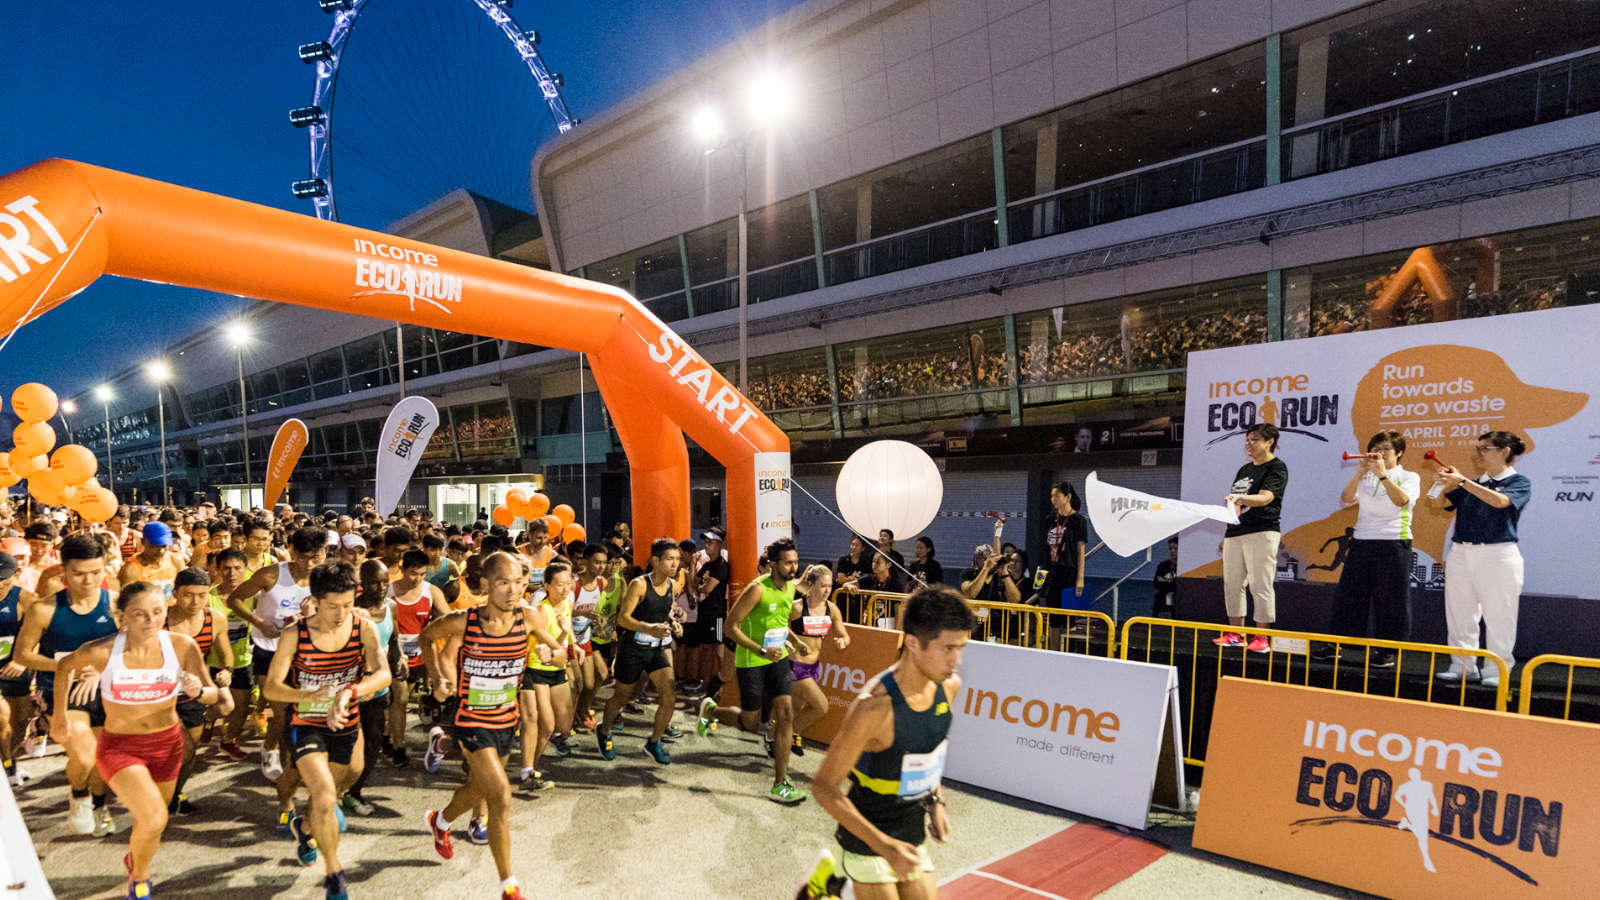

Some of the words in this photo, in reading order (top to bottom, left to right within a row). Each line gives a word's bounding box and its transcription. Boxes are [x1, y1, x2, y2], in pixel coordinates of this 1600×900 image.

[0, 195, 69, 283] RT
[355, 258, 401, 291] ECO
[419, 269, 463, 303] RUN
[649, 332, 759, 435] START
[1383, 363, 1425, 381] Run
[1382, 377, 1475, 399] towards
[1207, 400, 1257, 433] ECO
[1280, 394, 1339, 428] RUN
[1380, 402, 1429, 418] zero
[1434, 394, 1506, 415] waste
[395, 438, 414, 459] ECO
[408, 412, 426, 435] RUN
[1101, 430, 1110, 442] 2
[1403, 426, 1446, 439] APRIL
[1450, 423, 1490, 438] 2018
[759, 478, 776, 491] ECO
[1555, 491, 1595, 502] RUN
[1016, 735, 1054, 752] made
[1059, 744, 1115, 765] different
[1296, 756, 1393, 819] ECO
[1439, 782, 1563, 858] RUN
